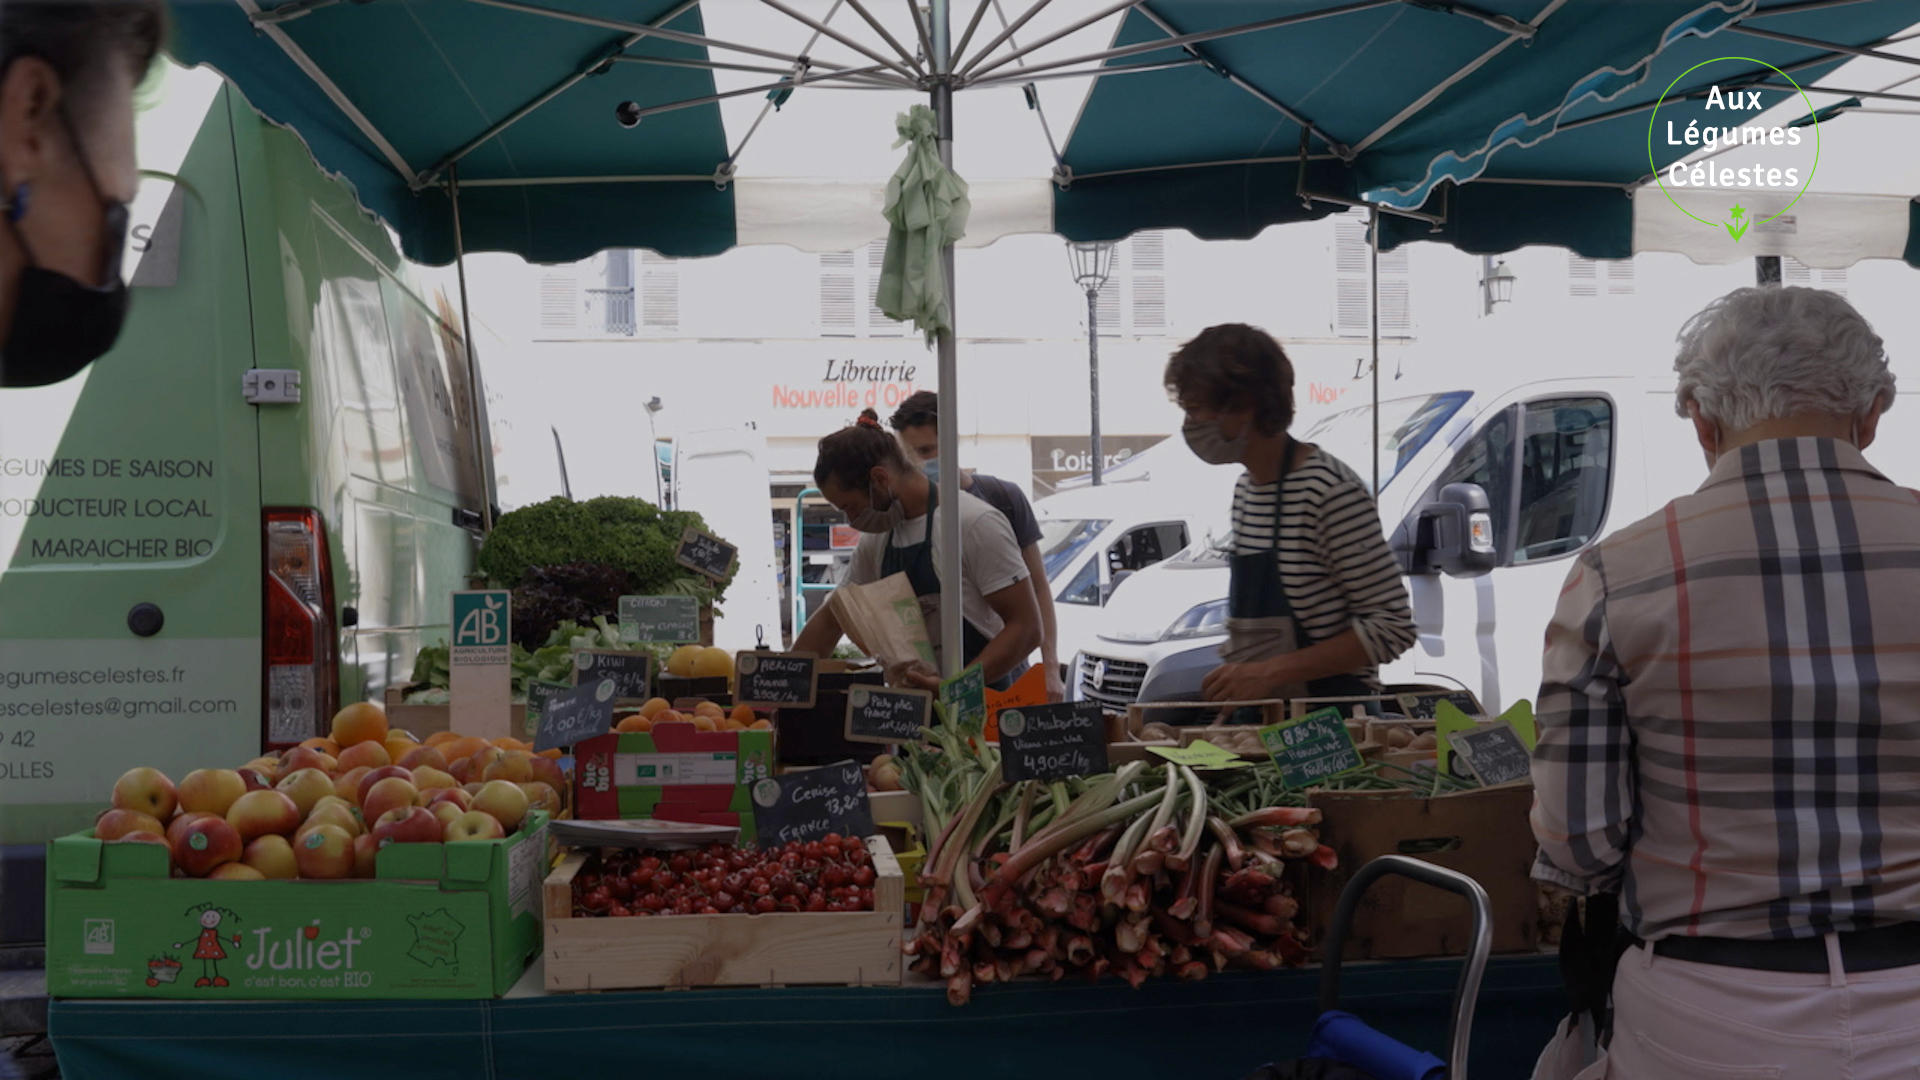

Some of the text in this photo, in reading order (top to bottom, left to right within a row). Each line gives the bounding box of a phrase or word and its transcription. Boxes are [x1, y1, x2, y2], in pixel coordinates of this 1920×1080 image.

[822, 359, 916, 382] Librairie
[773, 383, 858, 408] Nouvelle
[0, 459, 213, 478] GUMES DE SAISON
[0, 499, 213, 517] ODUCTEUR LOCAL
[32, 539, 213, 557] MARAICHER BIO
[457, 608, 500, 644] AB
[1027, 711, 1093, 732] Rhubarbe
[11, 731, 35, 748] 42
[344, 972, 372, 988] BIO
